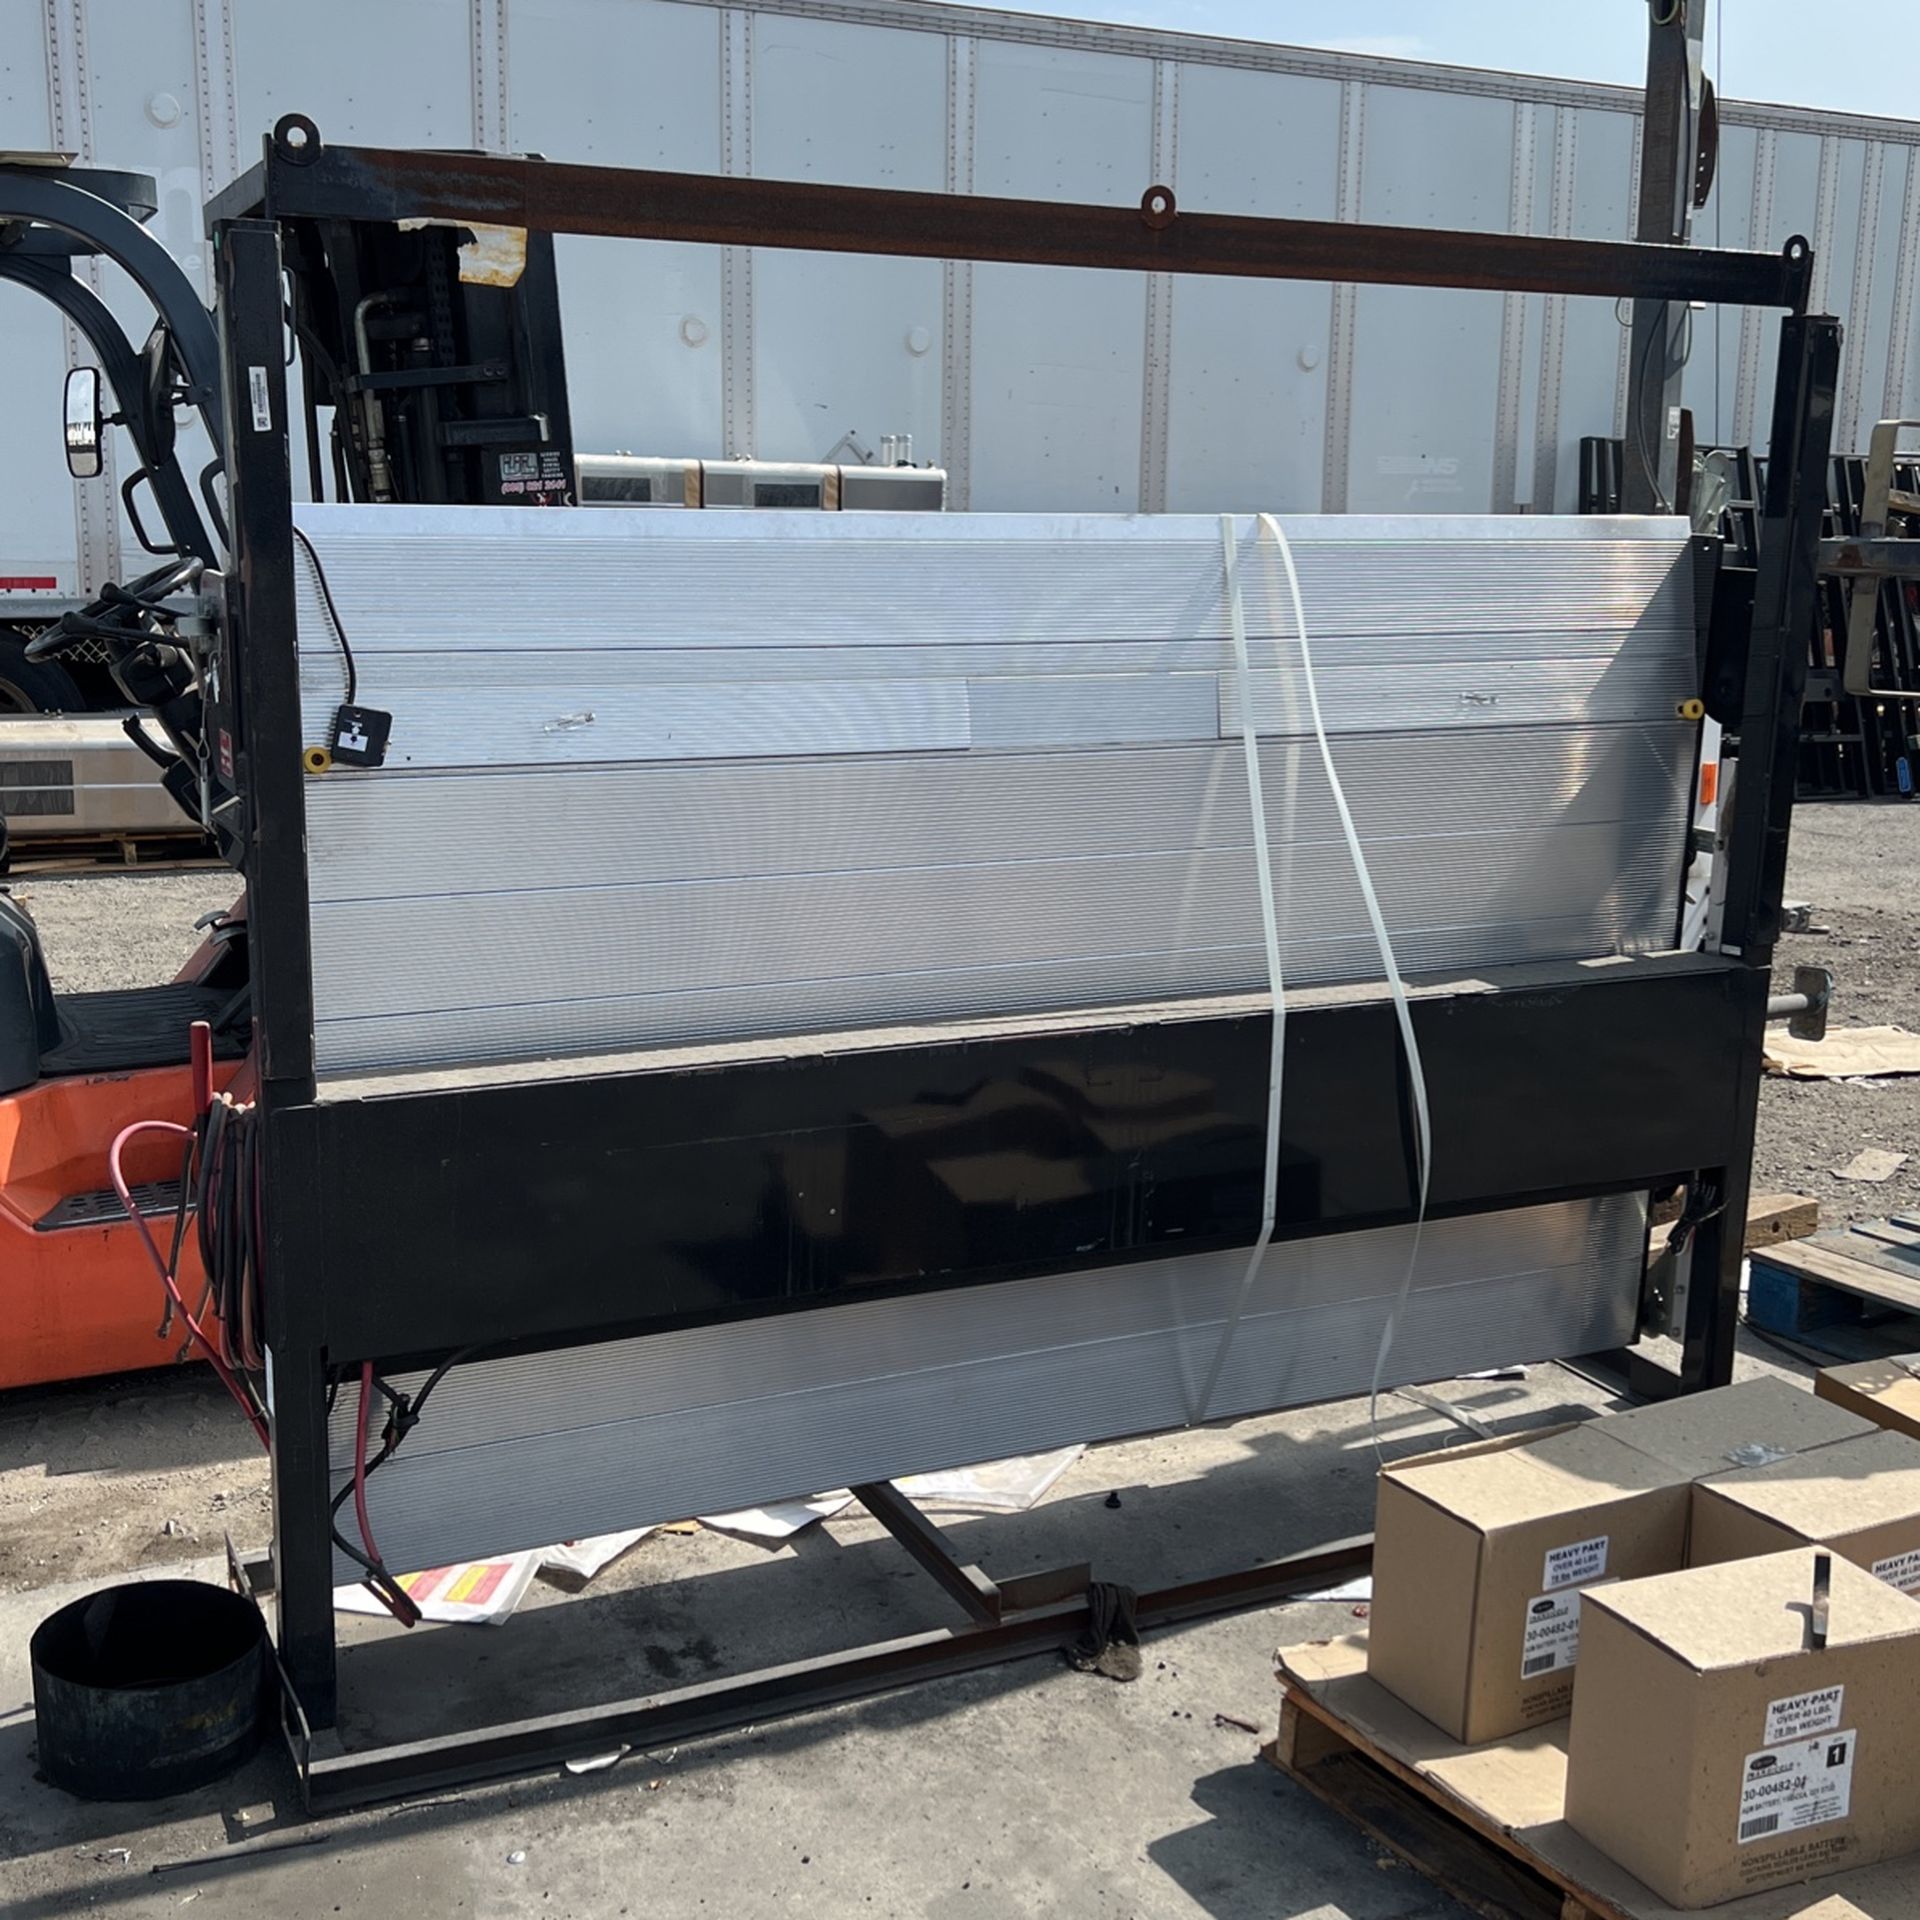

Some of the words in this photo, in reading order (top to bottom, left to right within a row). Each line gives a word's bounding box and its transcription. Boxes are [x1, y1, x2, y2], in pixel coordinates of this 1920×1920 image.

[1549, 1547, 1580, 1563] HEAVY
[1582, 1540, 1606, 1554] PART
[1552, 1560, 1573, 1572] OVER
[1574, 1557, 1583, 1566] 40
[1572, 1563, 1599, 1577] WEIGHT
[1875, 1557, 1906, 1573] HEAVY
[1772, 1697, 1809, 1715] HEAVY
[1811, 1690, 1840, 1705] PART
[1776, 1711, 1800, 1725] OVER
[1802, 1708, 1812, 1718] 40
[1799, 1715, 1833, 1731] WEIGHT
[1740, 1845, 1806, 1868] NONSPILLABLE
